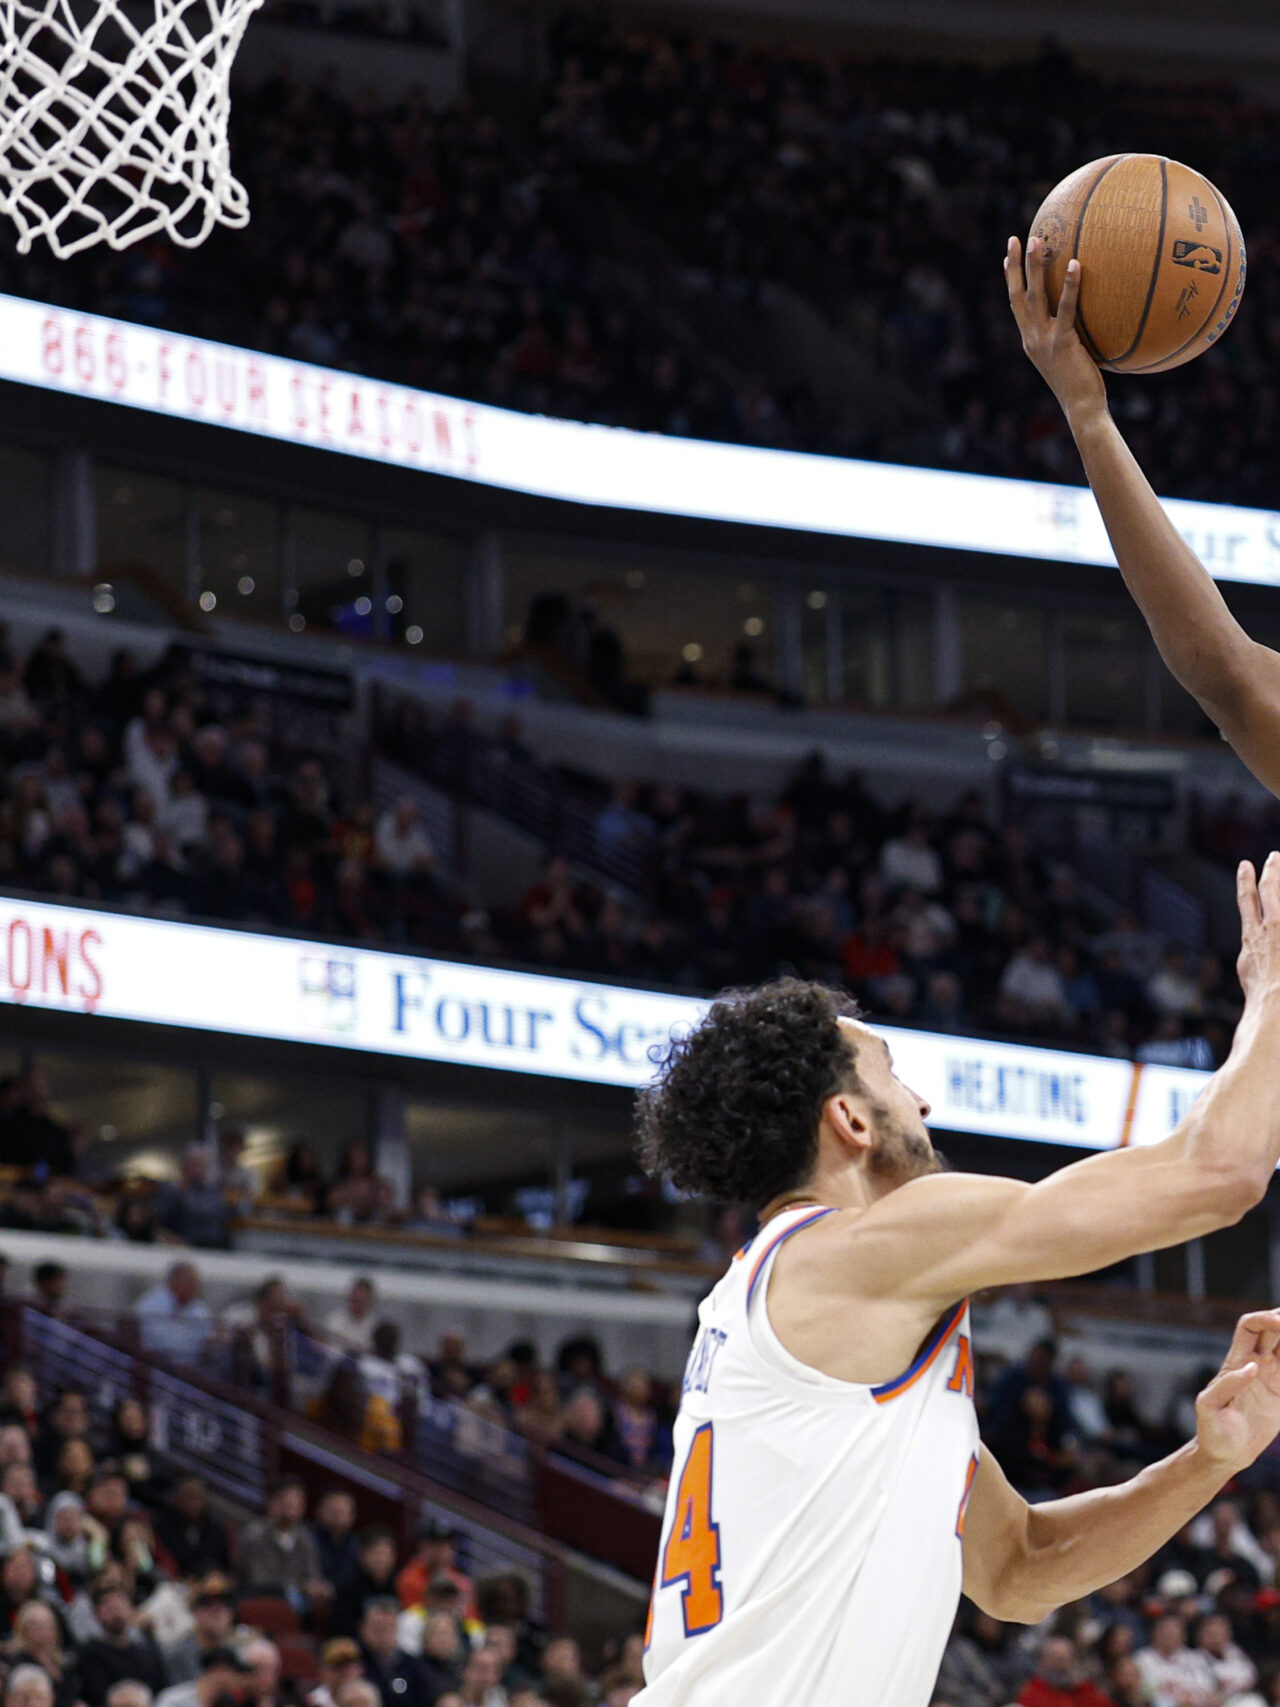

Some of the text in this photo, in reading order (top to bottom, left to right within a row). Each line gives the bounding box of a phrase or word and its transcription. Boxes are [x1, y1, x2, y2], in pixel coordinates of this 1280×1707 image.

[291, 376, 480, 469] SEASONS
[8, 918, 104, 1003] ONS
[390, 967, 555, 1053] Four
[945, 1056, 1087, 1127] HEATING
[643, 1421, 724, 1639] 4
